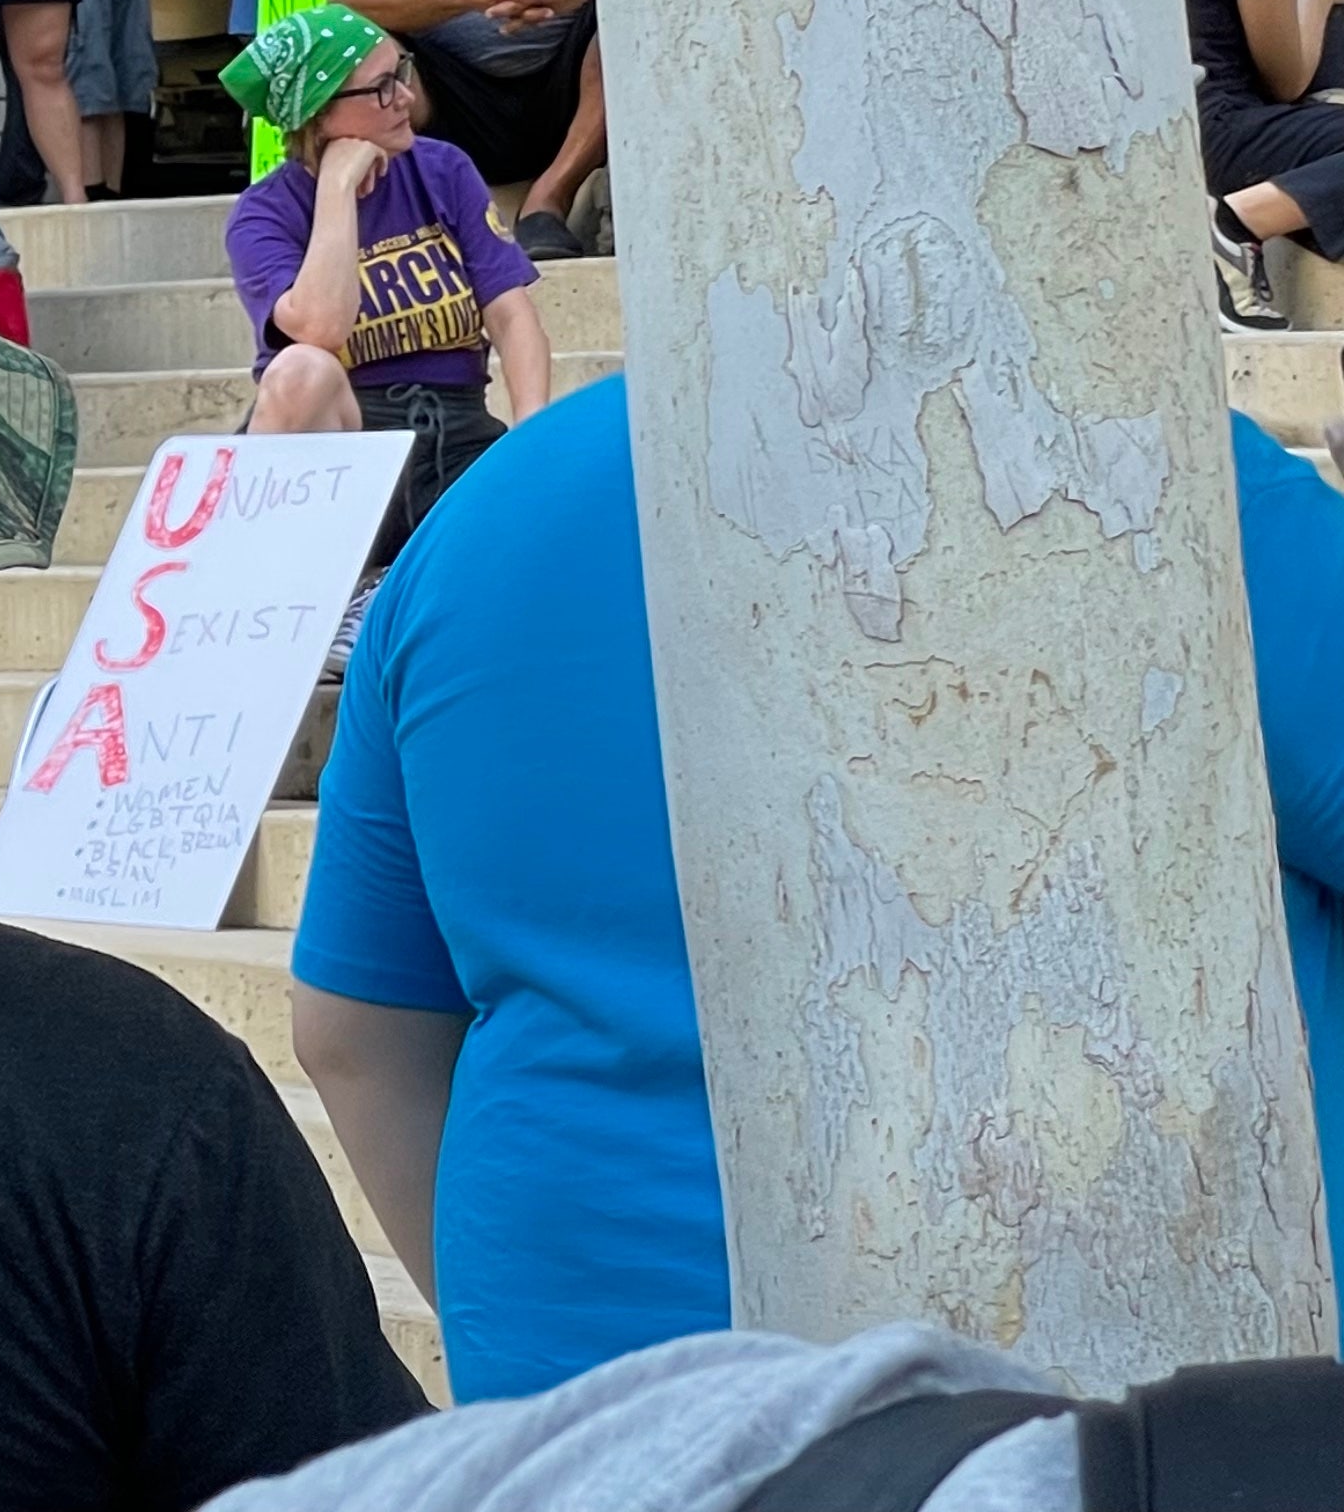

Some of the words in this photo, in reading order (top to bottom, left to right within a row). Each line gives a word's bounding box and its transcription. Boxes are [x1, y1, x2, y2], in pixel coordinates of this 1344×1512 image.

[355, 241, 466, 320] ARCH
[95, 561, 317, 673] SEXIST
[23, 681, 242, 794] ANTI
[105, 802, 240, 837] LGBTQIA
[113, 764, 231, 813] WOMEN
